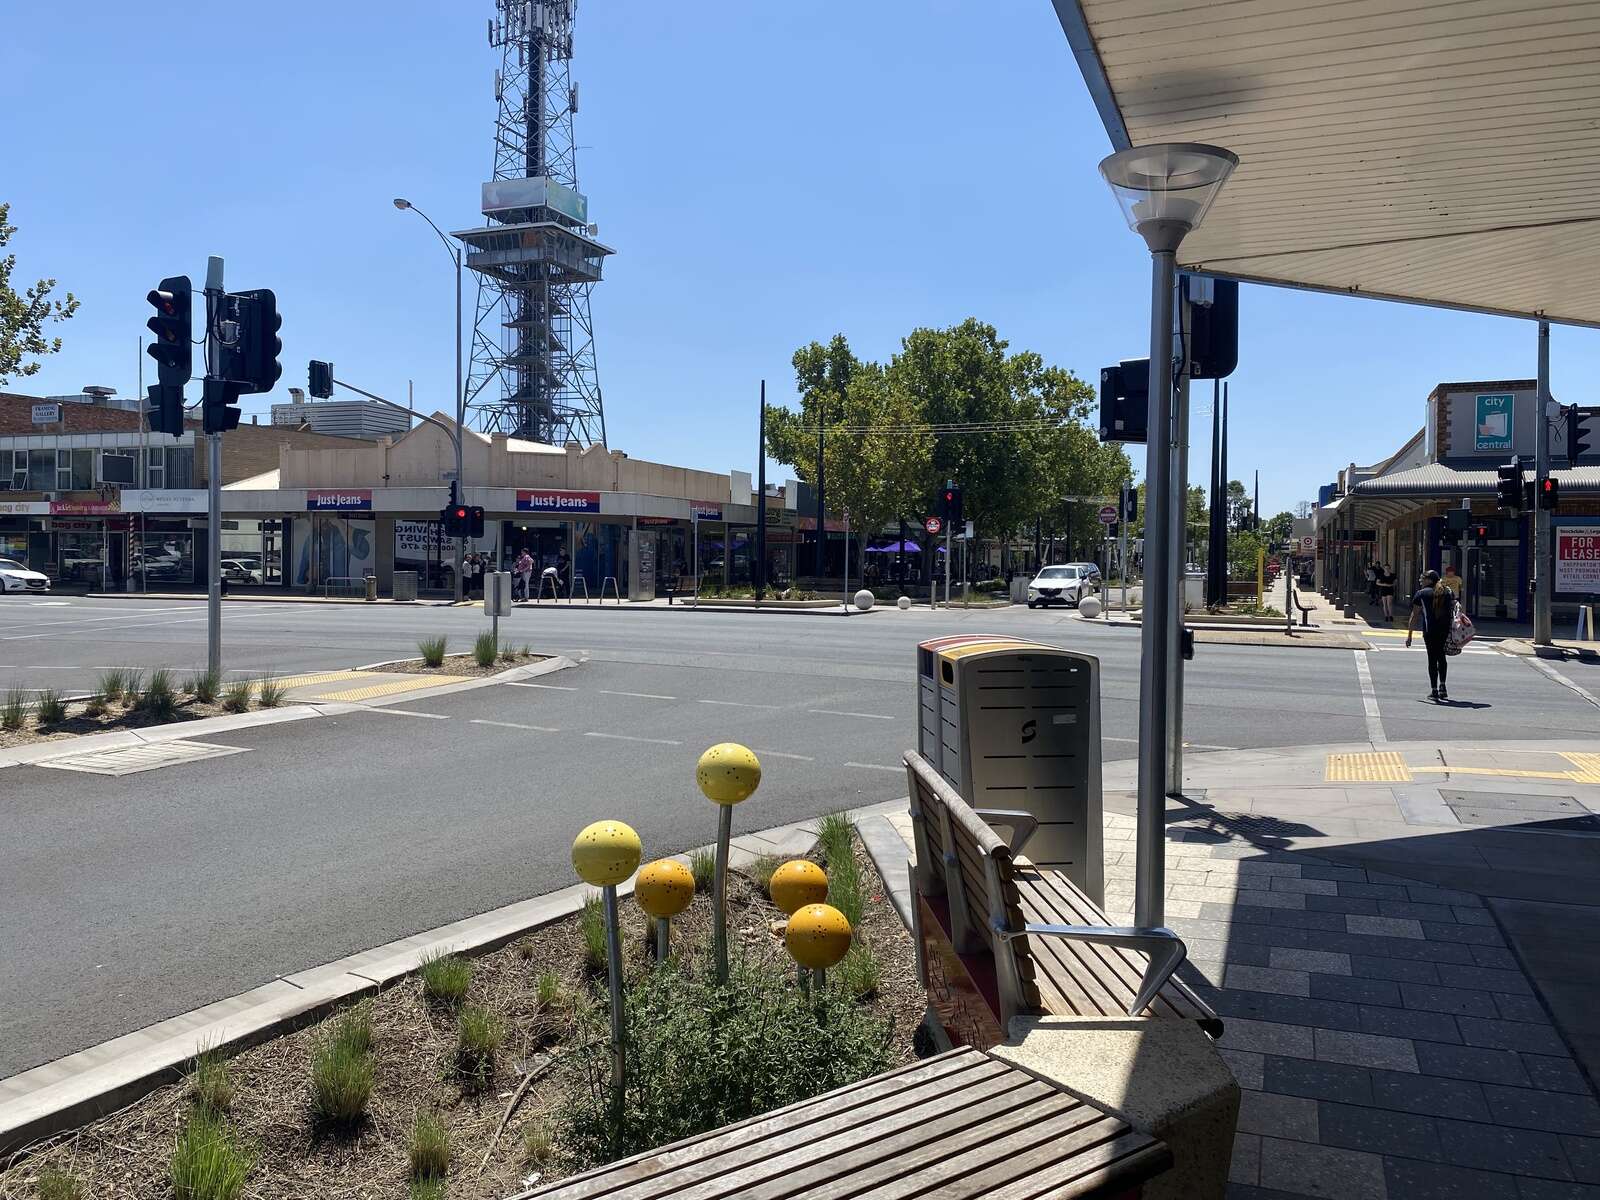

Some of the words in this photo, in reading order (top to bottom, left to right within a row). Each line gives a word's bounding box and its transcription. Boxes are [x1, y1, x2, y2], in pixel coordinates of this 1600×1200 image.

[1485, 396, 1505, 407] city
[1476, 439, 1511, 449] central
[317, 494, 336, 506] Just
[336, 494, 361, 506] Jeans
[530, 494, 555, 507] Just
[556, 495, 588, 508] Jeans
[1571, 537, 1594, 548] FOR
[1564, 548, 1600, 560] LEASE
